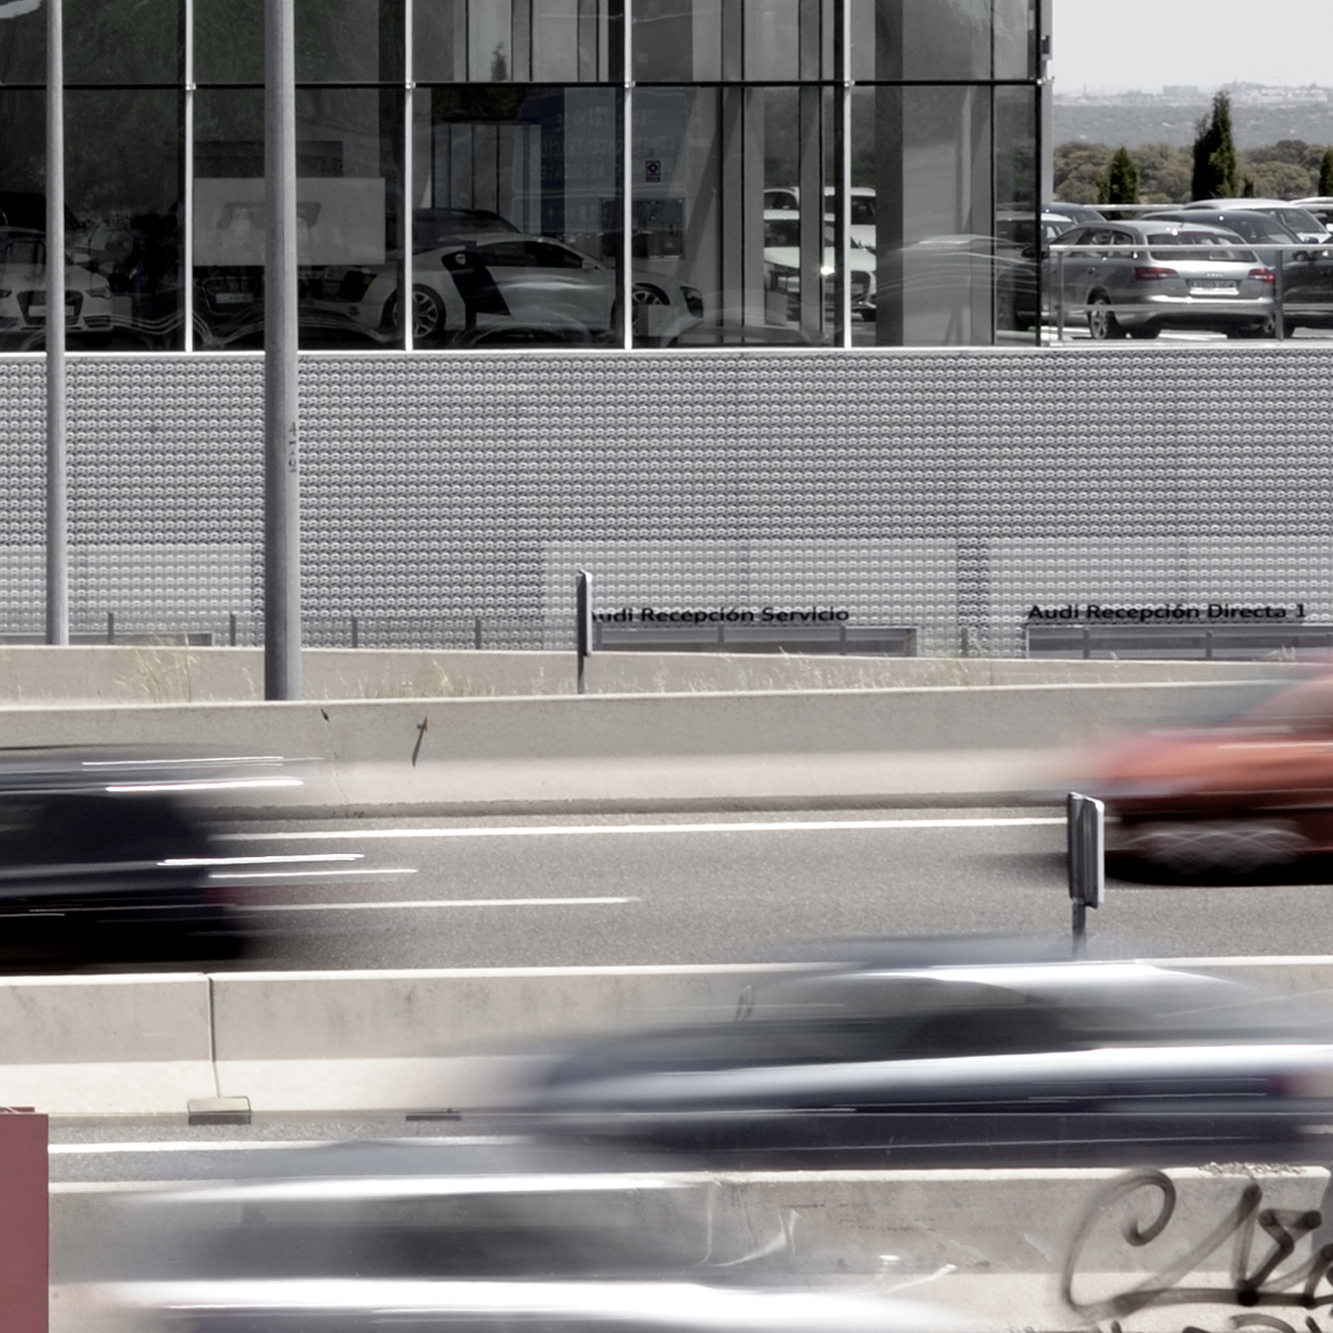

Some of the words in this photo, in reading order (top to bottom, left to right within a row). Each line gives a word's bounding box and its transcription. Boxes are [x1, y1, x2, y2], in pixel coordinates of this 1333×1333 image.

[640, 606, 755, 624] Recepción
[760, 605, 850, 623] Servicio
[1027, 604, 1080, 620] Audi
[1087, 603, 1201, 623] Recepción
[1207, 603, 1288, 619] Directa
[1295, 603, 1306, 617] 1
